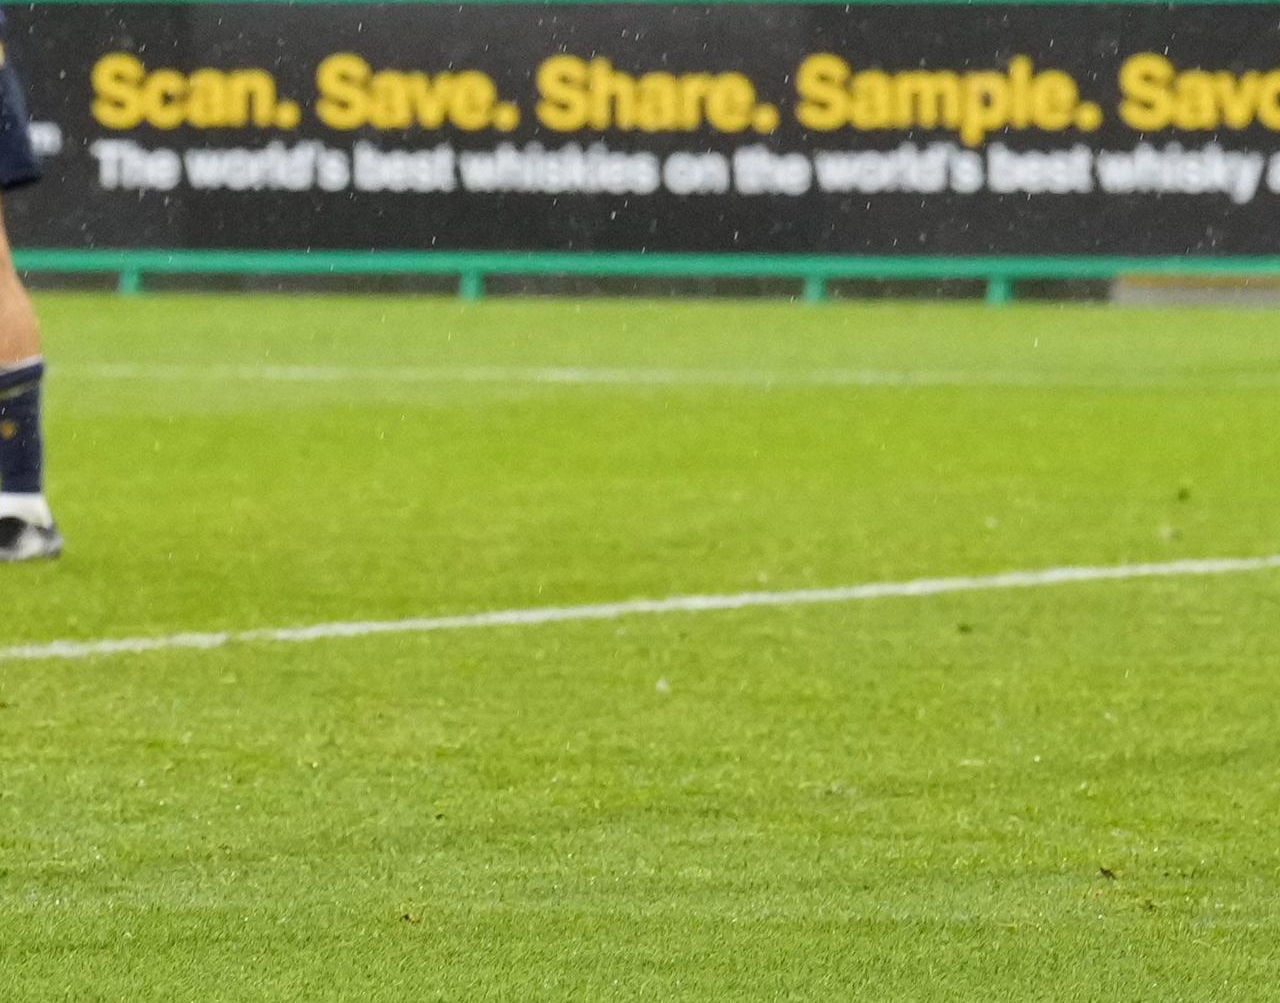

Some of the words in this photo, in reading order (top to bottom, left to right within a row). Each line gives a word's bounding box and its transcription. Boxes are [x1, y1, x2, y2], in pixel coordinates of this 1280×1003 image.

[91, 52, 301, 130] Scan.
[316, 52, 519, 132] Save.
[535, 53, 779, 134] Share.
[796, 52, 1103, 146] Sample.
[90, 139, 181, 190] The
[183, 139, 350, 191] world's
[353, 140, 455, 192] best
[459, 141, 660, 195] whiskies
[664, 151, 730, 195] on
[733, 144, 812, 195] the
[814, 141, 985, 194] world's
[987, 142, 1093, 194] best
[1096, 141, 1264, 204] whisky
